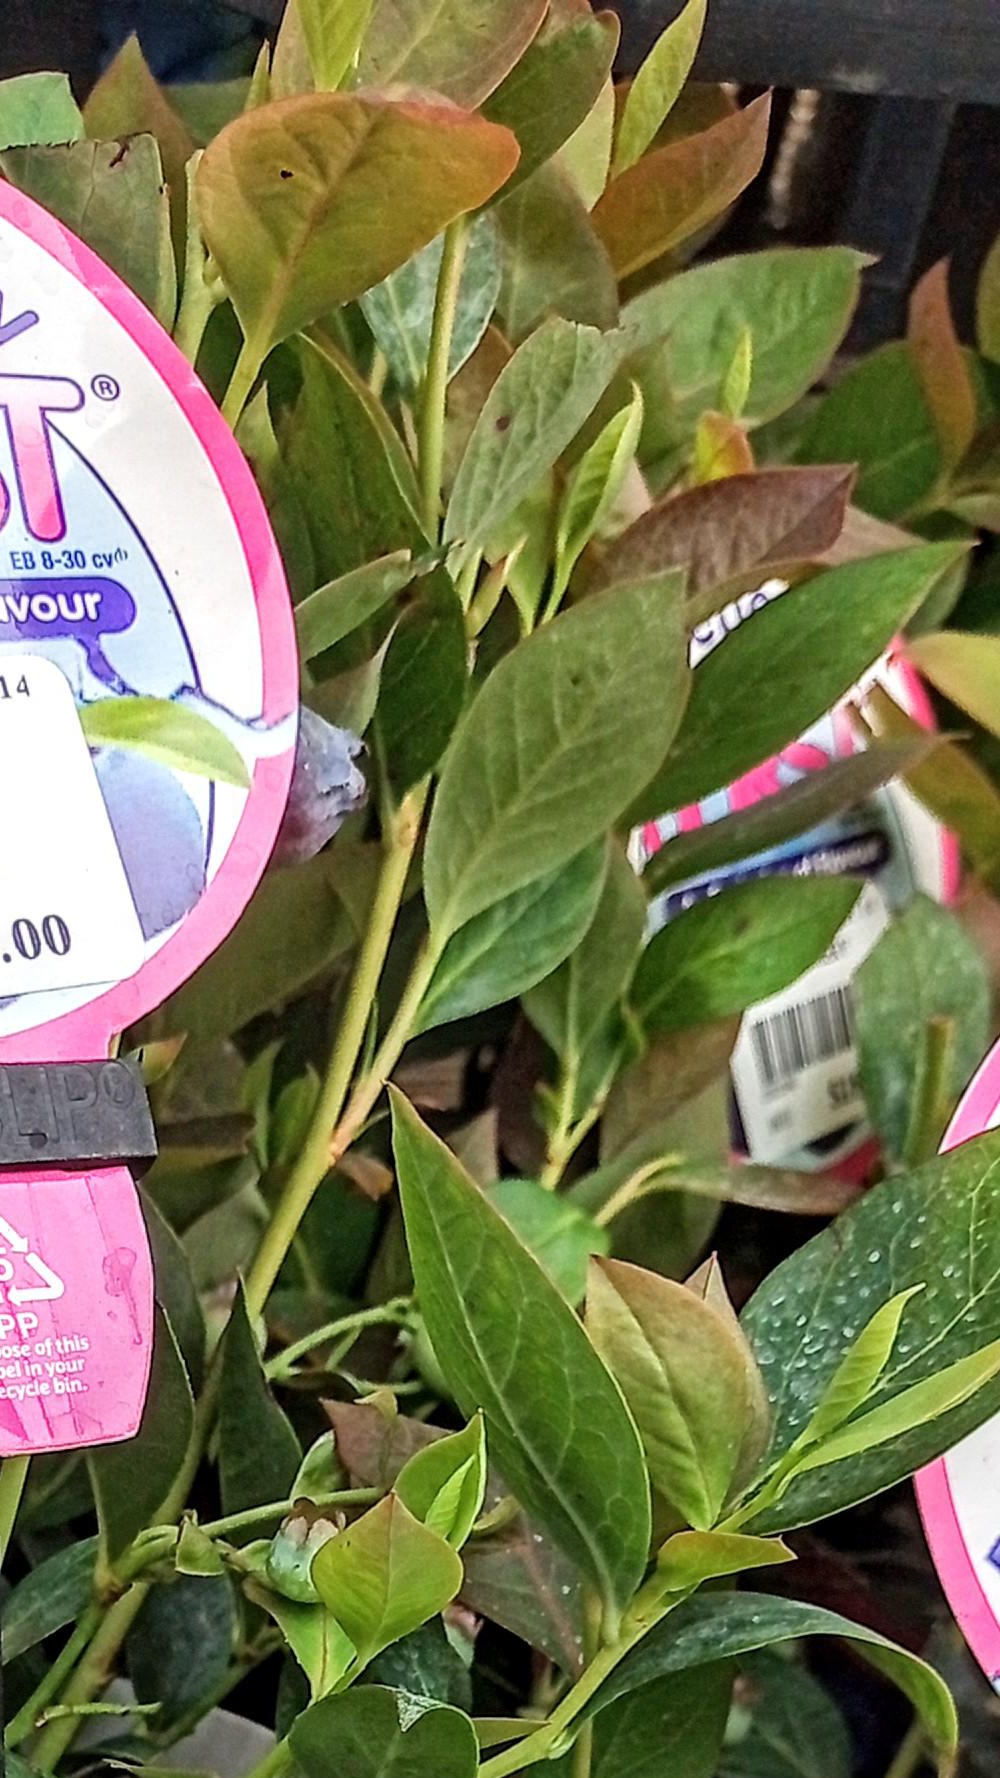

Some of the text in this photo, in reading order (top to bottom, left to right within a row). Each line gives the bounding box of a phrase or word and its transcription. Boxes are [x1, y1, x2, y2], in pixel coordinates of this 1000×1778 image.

[9, 550, 36, 570] EB
[41, 549, 86, 570] 8-30
[34, 1338, 53, 1357] of
[56, 1335, 90, 1354] this
[25, 1361, 42, 1377] in
[44, 1358, 86, 1377] your
[53, 1376, 89, 1394] bin.
